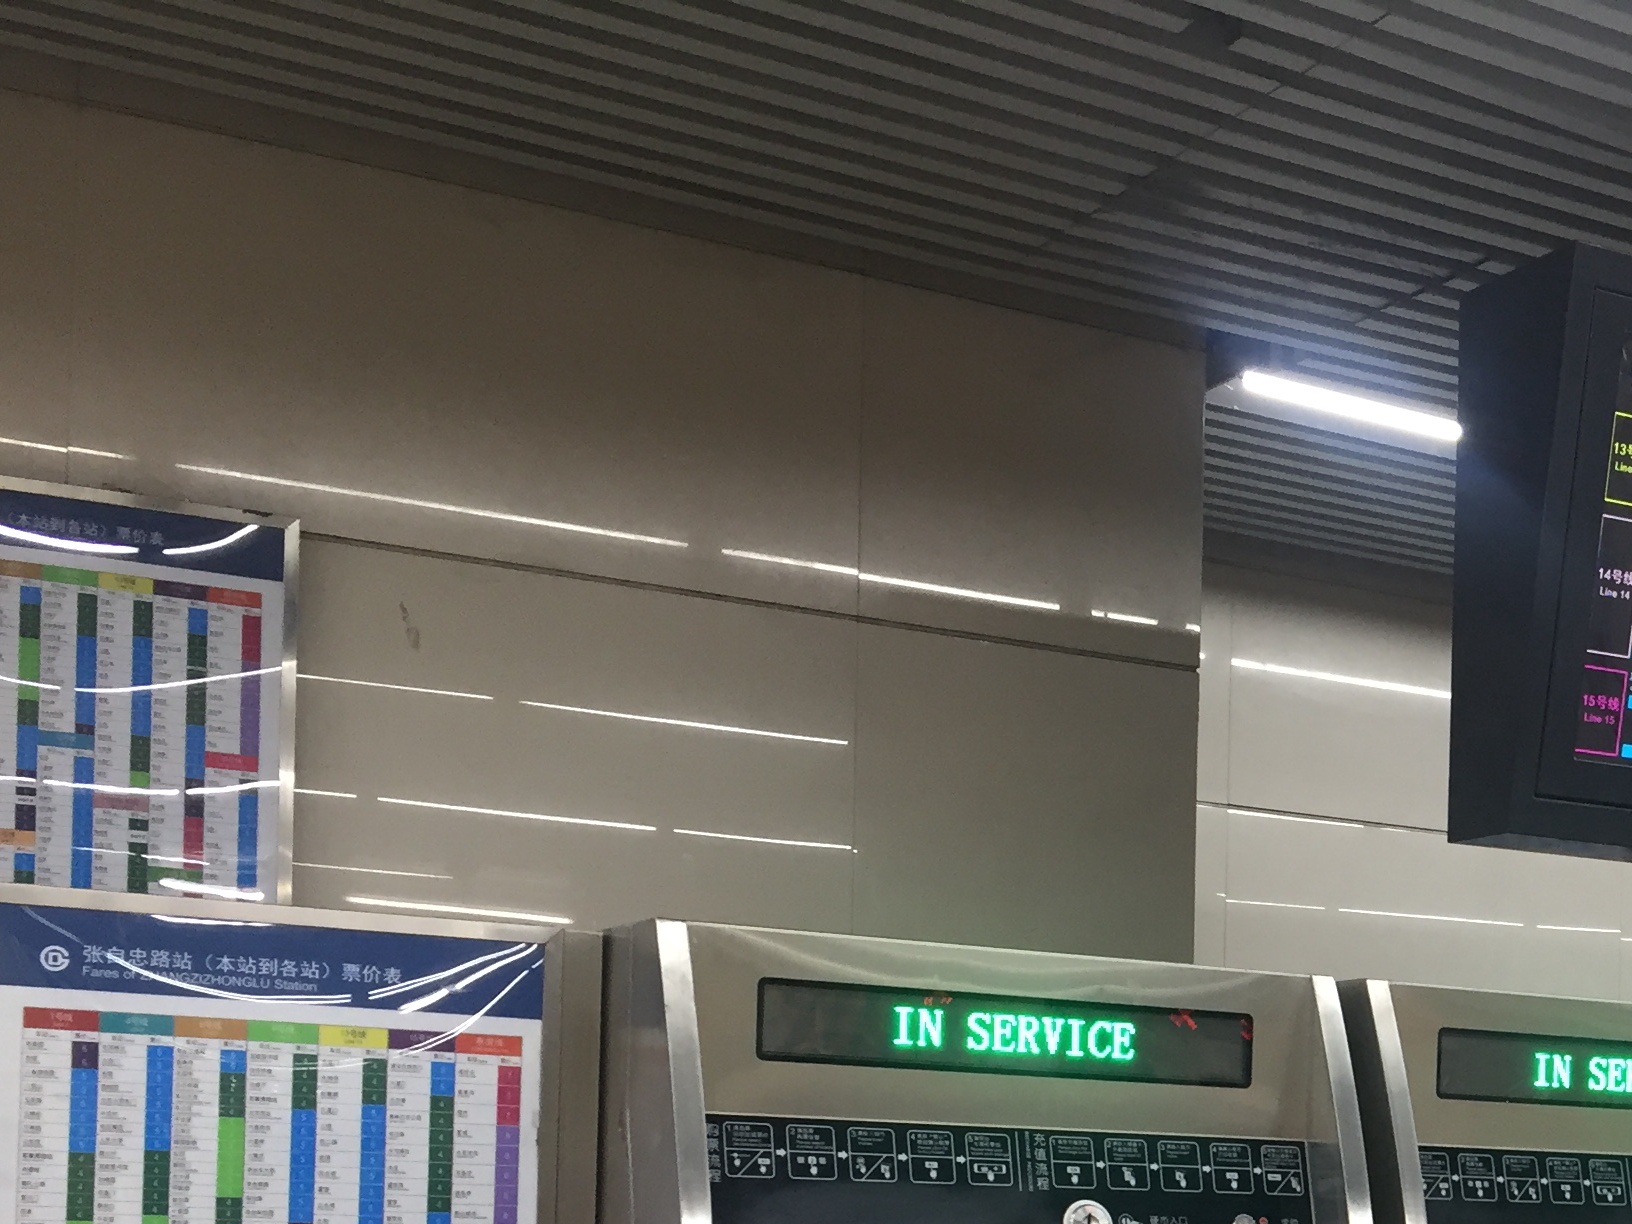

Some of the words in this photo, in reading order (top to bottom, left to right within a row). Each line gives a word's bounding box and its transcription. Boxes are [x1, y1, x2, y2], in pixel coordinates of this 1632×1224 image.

[1615, 461, 1632, 473] Line
[1599, 586, 1618, 597] Line
[1621, 589, 1631, 600] 14
[1583, 694, 1620, 712] 15号线
[1605, 715, 1615, 725] 15
[894, 1007, 943, 1046] IN
[967, 1013, 1135, 1059] SERVICE
[1534, 1053, 1571, 1088] IN
